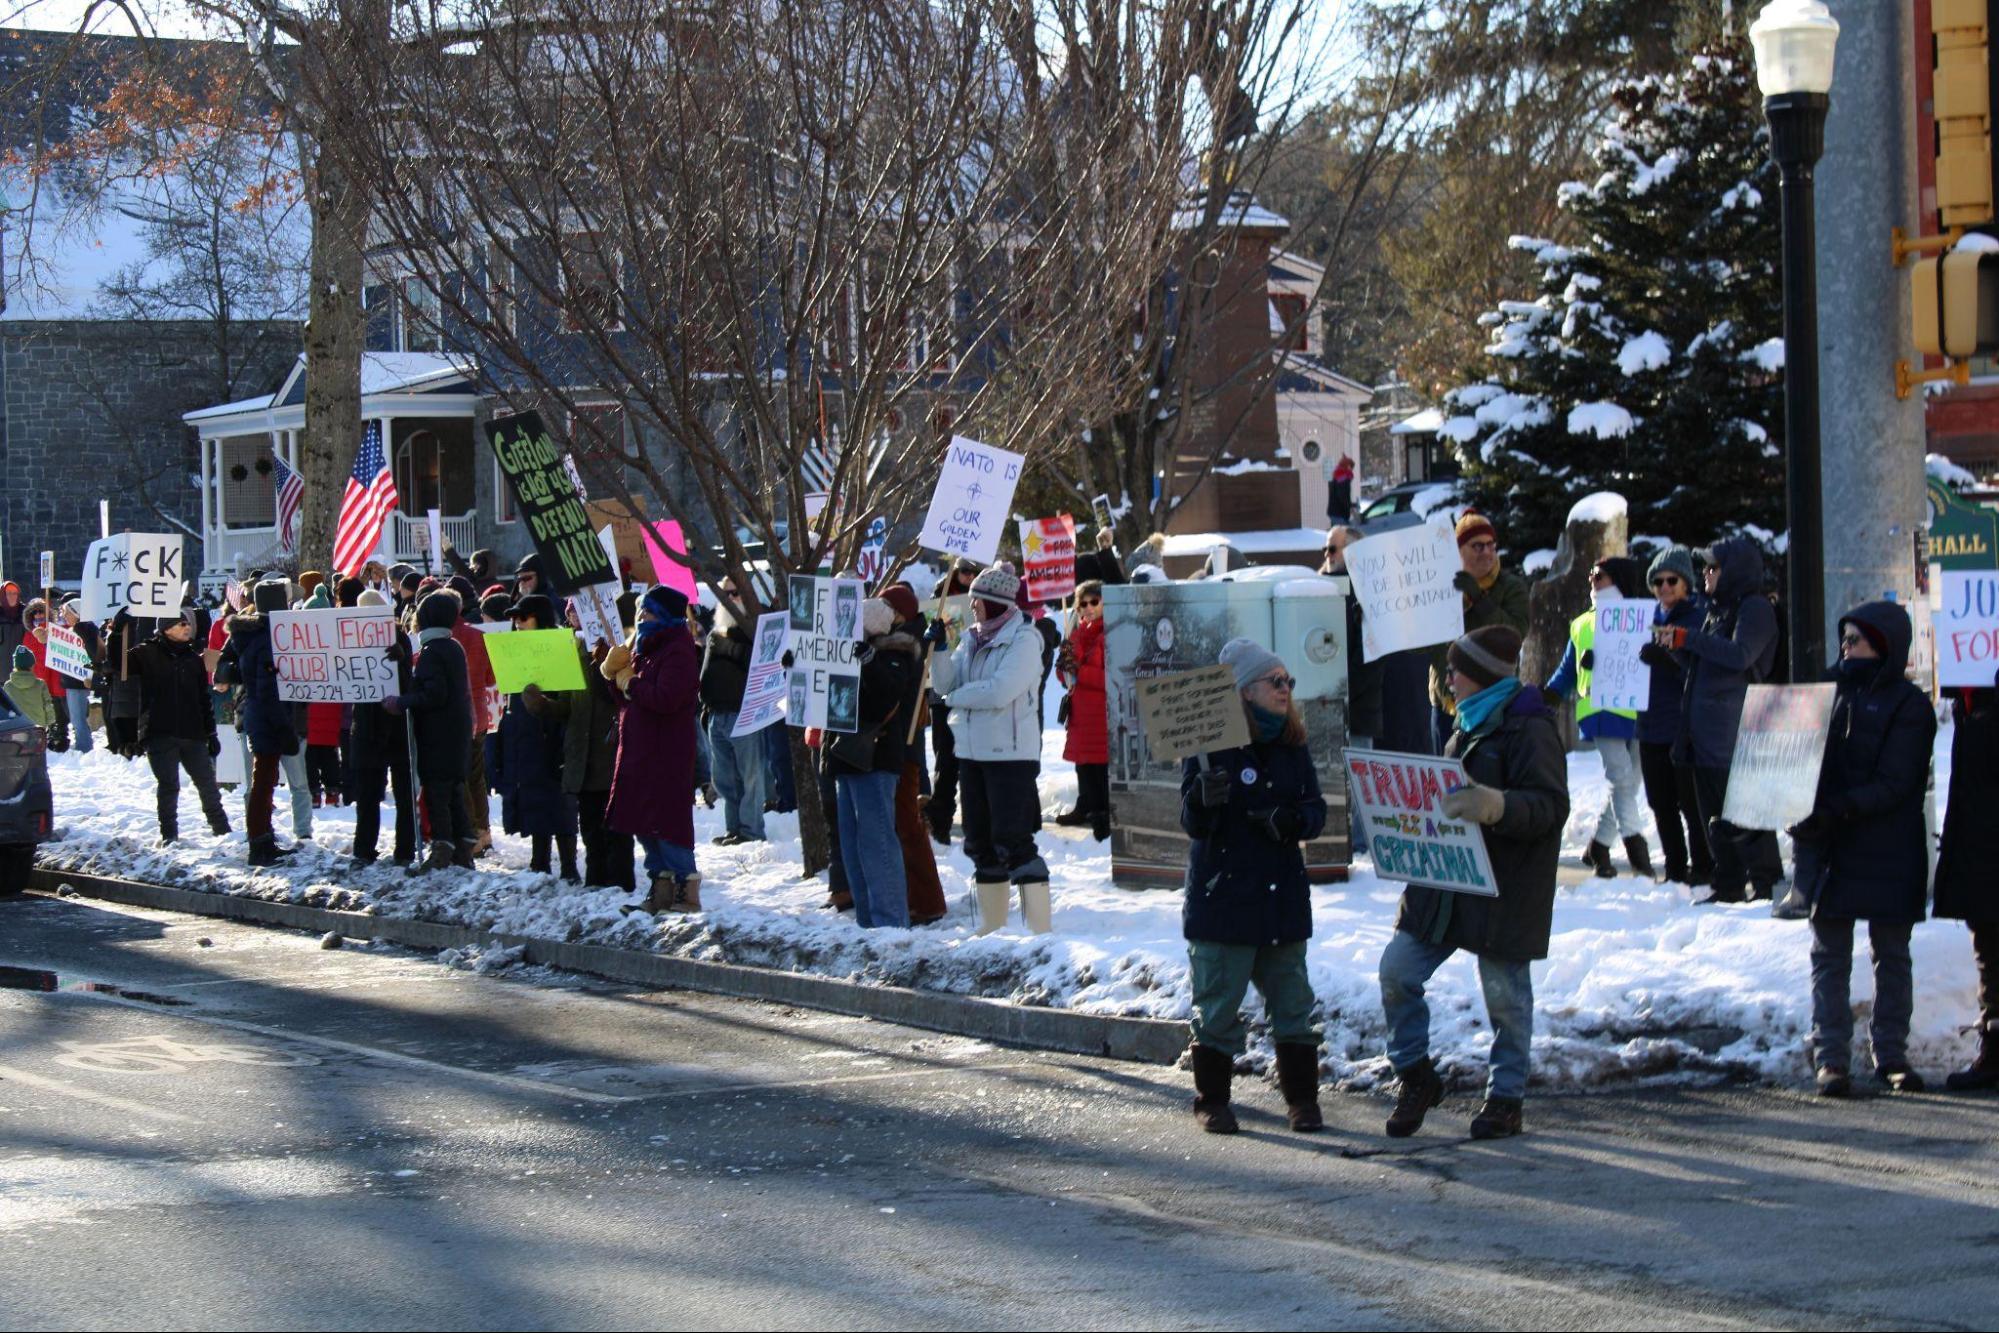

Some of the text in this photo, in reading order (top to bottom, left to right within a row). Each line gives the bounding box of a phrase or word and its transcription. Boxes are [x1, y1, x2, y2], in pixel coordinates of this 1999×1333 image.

[951, 447, 1018, 480] NATO IS
[524, 470, 550, 498] NOT
[531, 497, 586, 542] DEFEND
[953, 507, 980, 528] OUR
[556, 529, 608, 580] NATO
[1927, 533, 1987, 557] HALL
[1360, 543, 1444, 585] YOU WILL
[107, 581, 168, 608] ICE
[1373, 568, 1437, 594] BE HELD
[1951, 578, 1999, 620] JU
[1601, 607, 1645, 633] CRUSH
[51, 627, 76, 646] SPEAK
[273, 620, 394, 651] CALL FIGHT
[794, 636, 860, 665] AMERICA
[276, 655, 394, 682] CLUB REPS
[286, 683, 385, 700] 202-224-3121
[1600, 694, 1637, 708] ICE
[1349, 758, 1463, 812] TRUMP
[1400, 814, 1421, 836] IS
[1373, 833, 1487, 888] CRIMINAL
